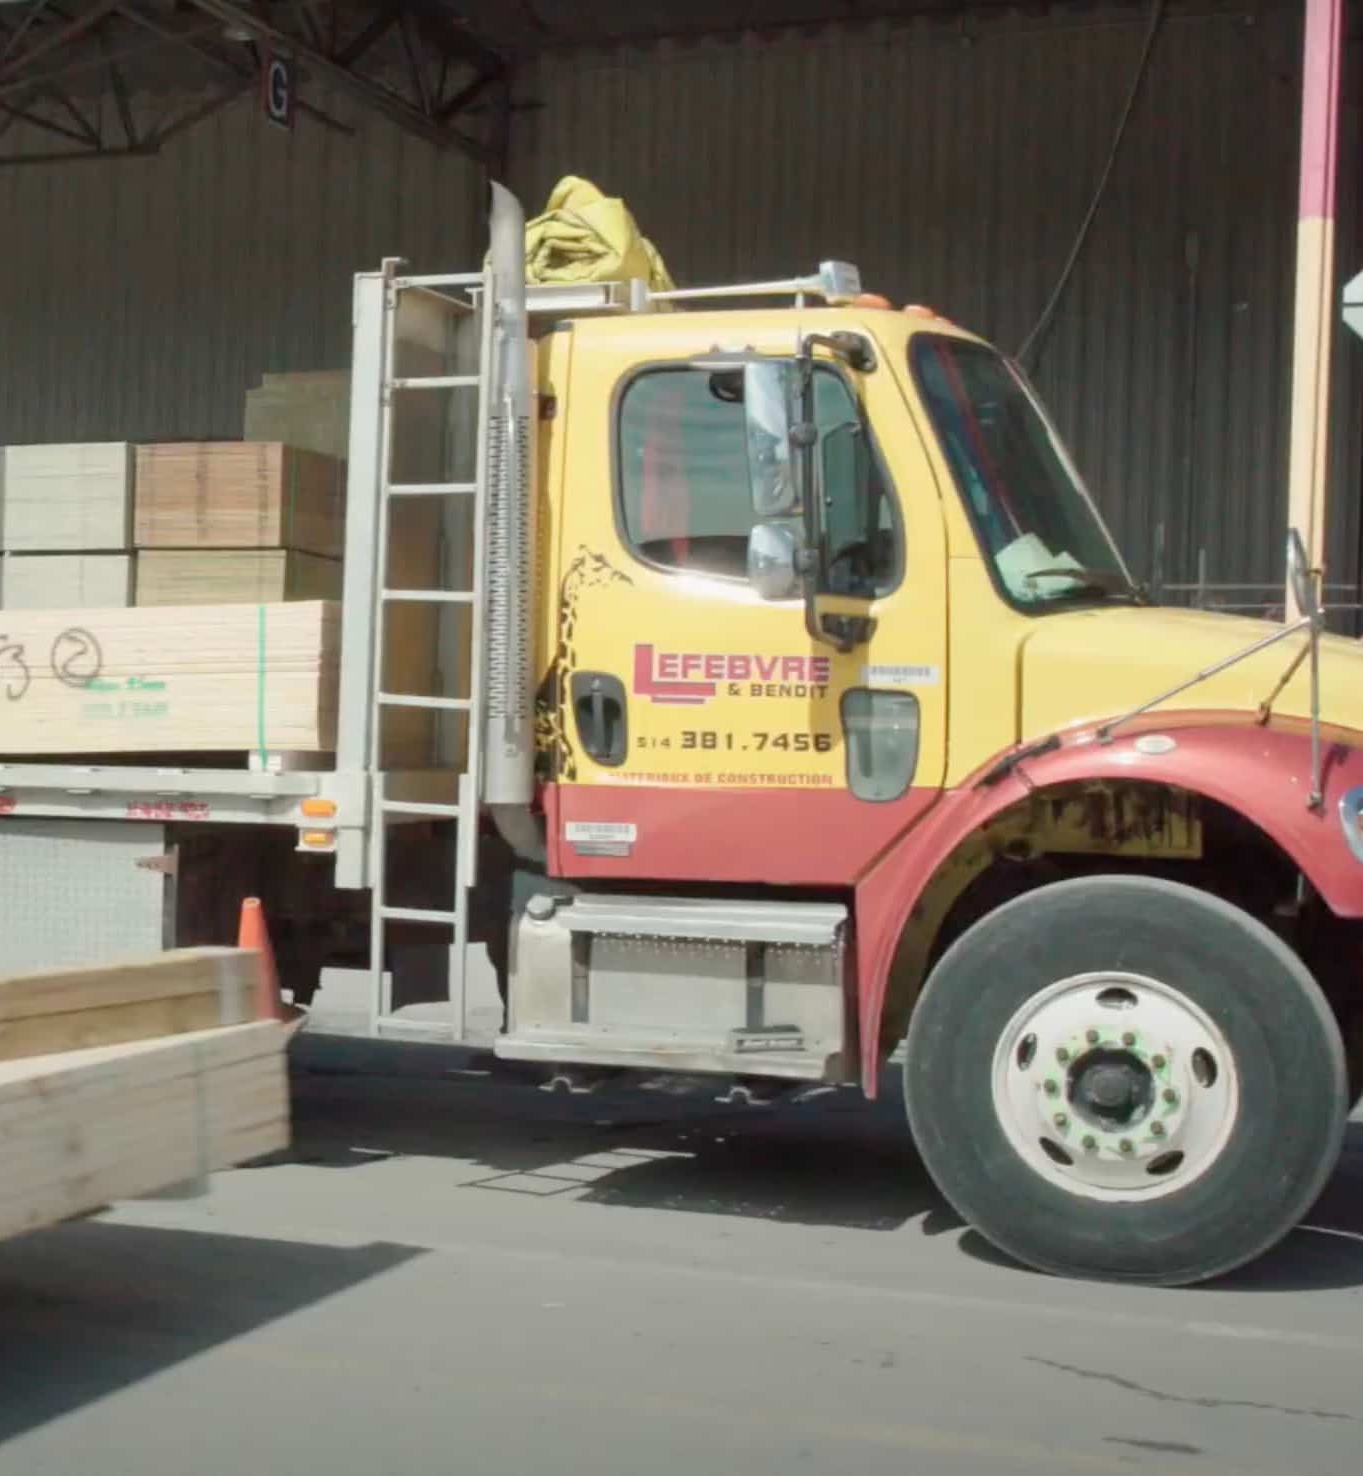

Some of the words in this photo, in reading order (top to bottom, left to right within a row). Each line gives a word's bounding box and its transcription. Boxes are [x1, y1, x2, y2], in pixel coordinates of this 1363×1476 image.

[269, 61, 288, 117] G
[634, 644, 830, 697] LEFEBVRE
[727, 683, 741, 697] &
[750, 683, 829, 699] BENOIT
[637, 736, 671, 749] 514
[681, 730, 833, 753] 381.7456
[717, 771, 833, 786] CONSTRUCTION
